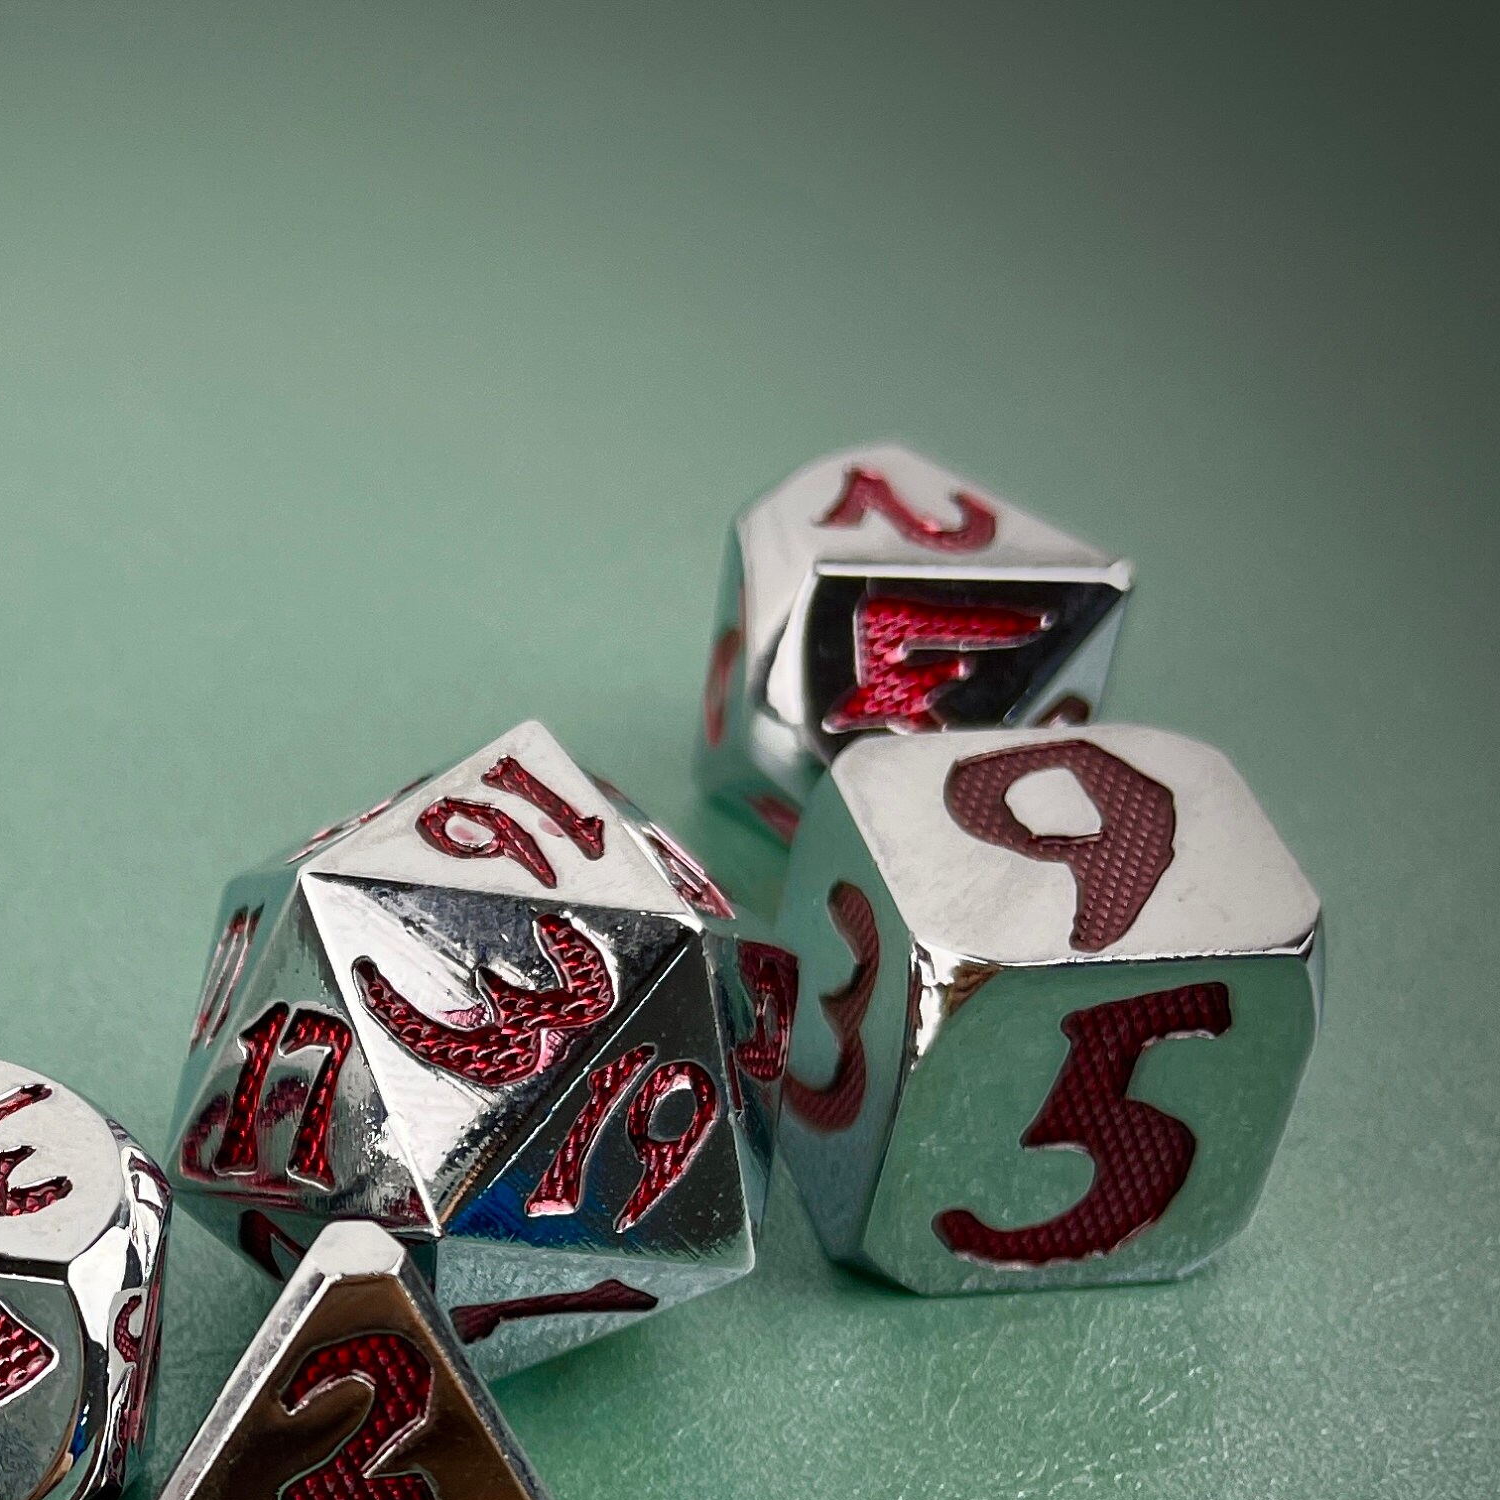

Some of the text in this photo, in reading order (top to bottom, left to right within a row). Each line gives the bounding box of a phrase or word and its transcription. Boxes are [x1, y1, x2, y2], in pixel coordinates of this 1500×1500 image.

[352, 909, 619, 1087] 3
[211, 1001, 354, 1195] 17
[524, 1042, 719, 1235] 19
[931, 980, 1232, 1270] 5
